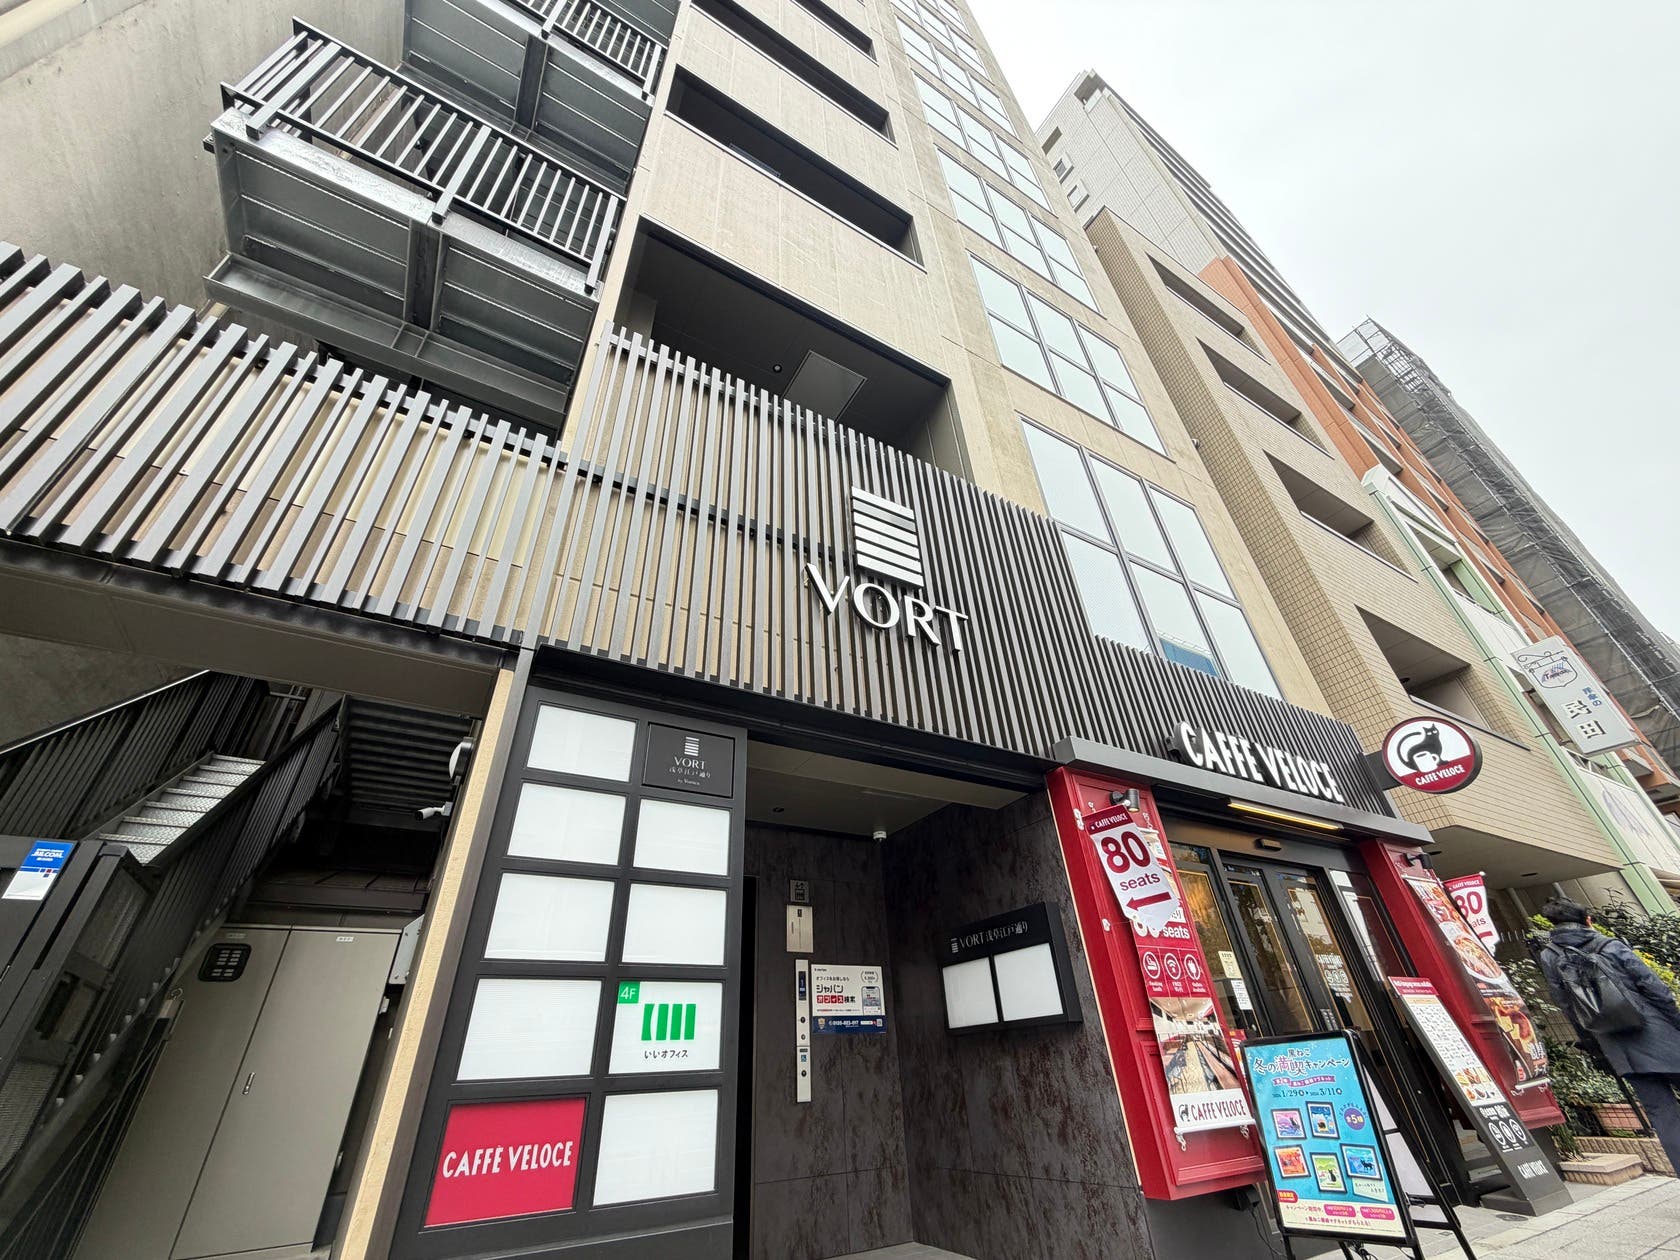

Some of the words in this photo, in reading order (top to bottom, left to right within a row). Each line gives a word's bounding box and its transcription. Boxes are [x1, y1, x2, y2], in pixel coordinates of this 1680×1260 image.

[806, 562, 969, 652] VORT
[674, 756, 706, 770] VORT
[1254, 741, 1346, 804] VELOCE
[1436, 764, 1466, 779] VELOCE
[1108, 812, 1129, 824] VELOCE
[1100, 831, 1151, 874] 80
[1119, 871, 1161, 892] seats
[1162, 925, 1191, 939] seats
[959, 931, 984, 949] VORT
[620, 986, 636, 1000] 4F
[815, 984, 844, 994] ジャパン
[816, 995, 856, 1004] オフィス検索
[644, 1049, 689, 1060] いいオフィス
[1287, 1048, 1311, 1057] 黒ねこ
[1254, 1055, 1350, 1076] 冬の満喫キャンペーン
[1281, 1089, 1298, 1097] 1/29
[1215, 1099, 1247, 1118] VELOCE
[508, 1140, 574, 1172] VELOCE
